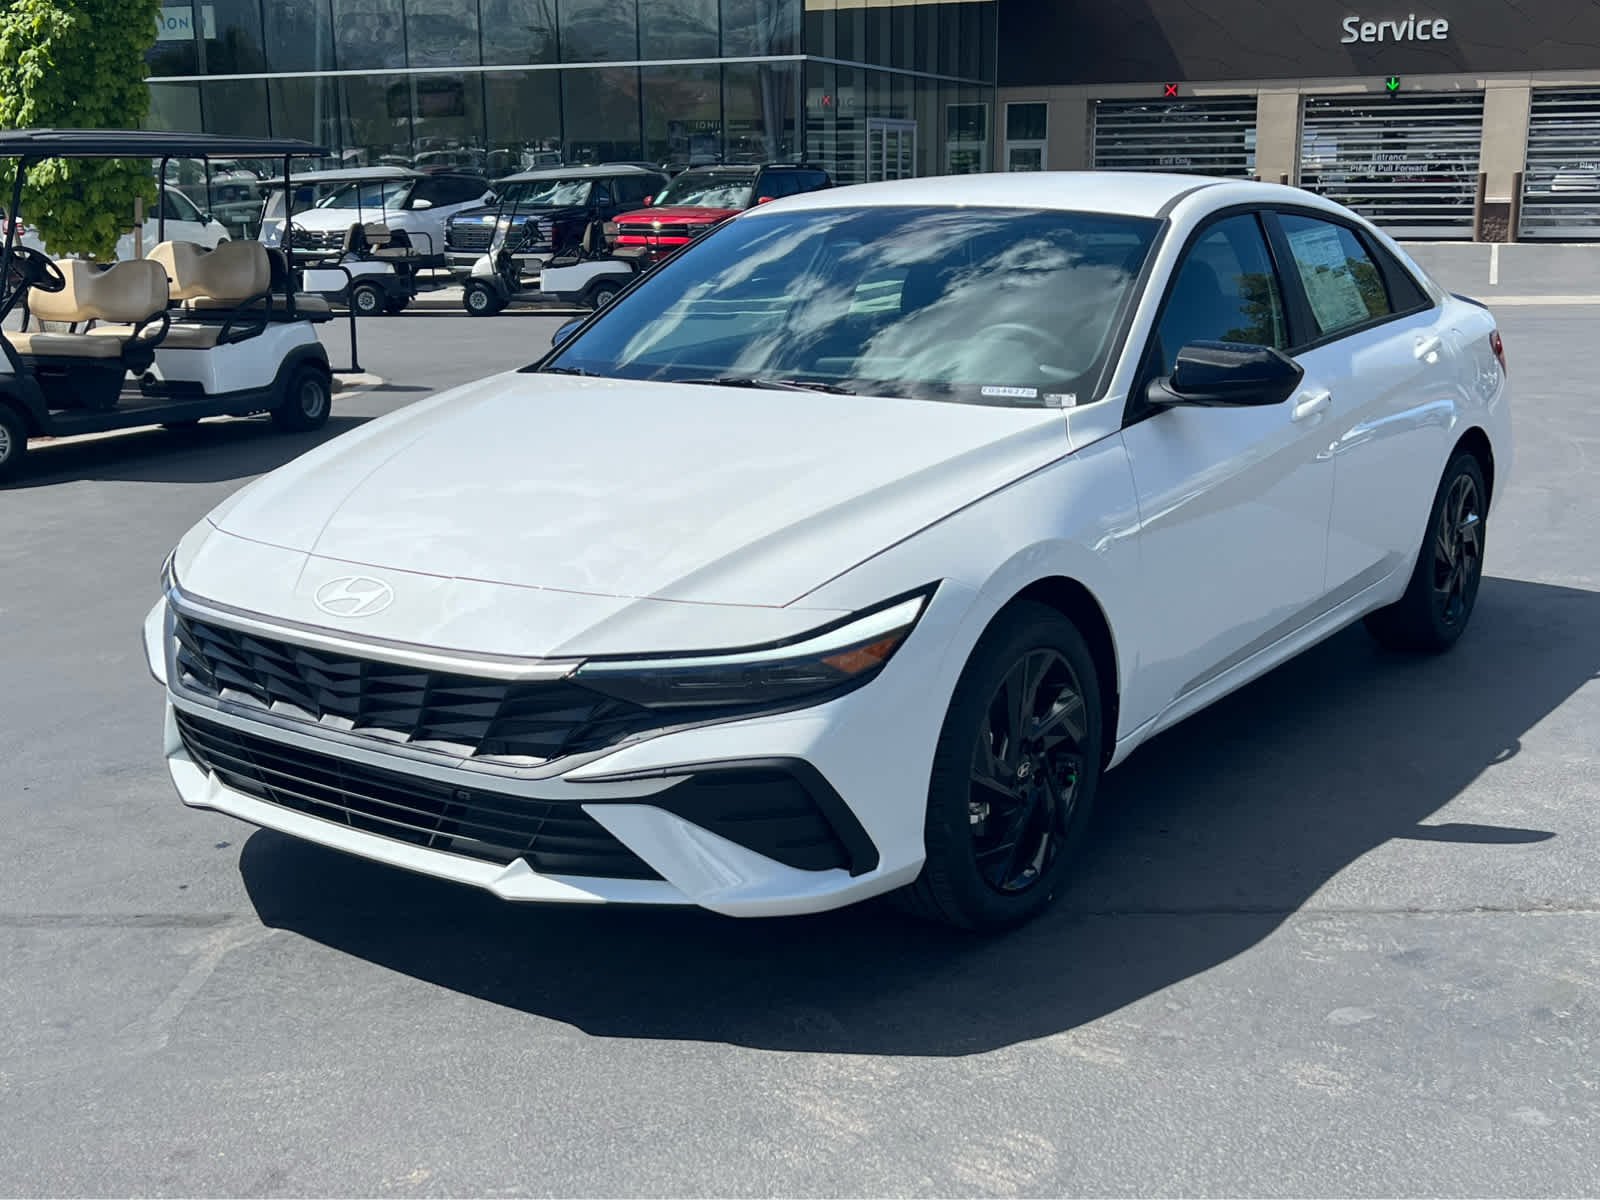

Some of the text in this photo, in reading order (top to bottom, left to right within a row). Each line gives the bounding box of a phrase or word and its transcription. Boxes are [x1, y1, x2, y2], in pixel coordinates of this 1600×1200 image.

[1341, 13, 1449, 43] Service
[1175, 156, 1191, 167] Only
[1372, 152, 1407, 161] Entrance
[1350, 163, 1428, 173] Please Pull Forward
